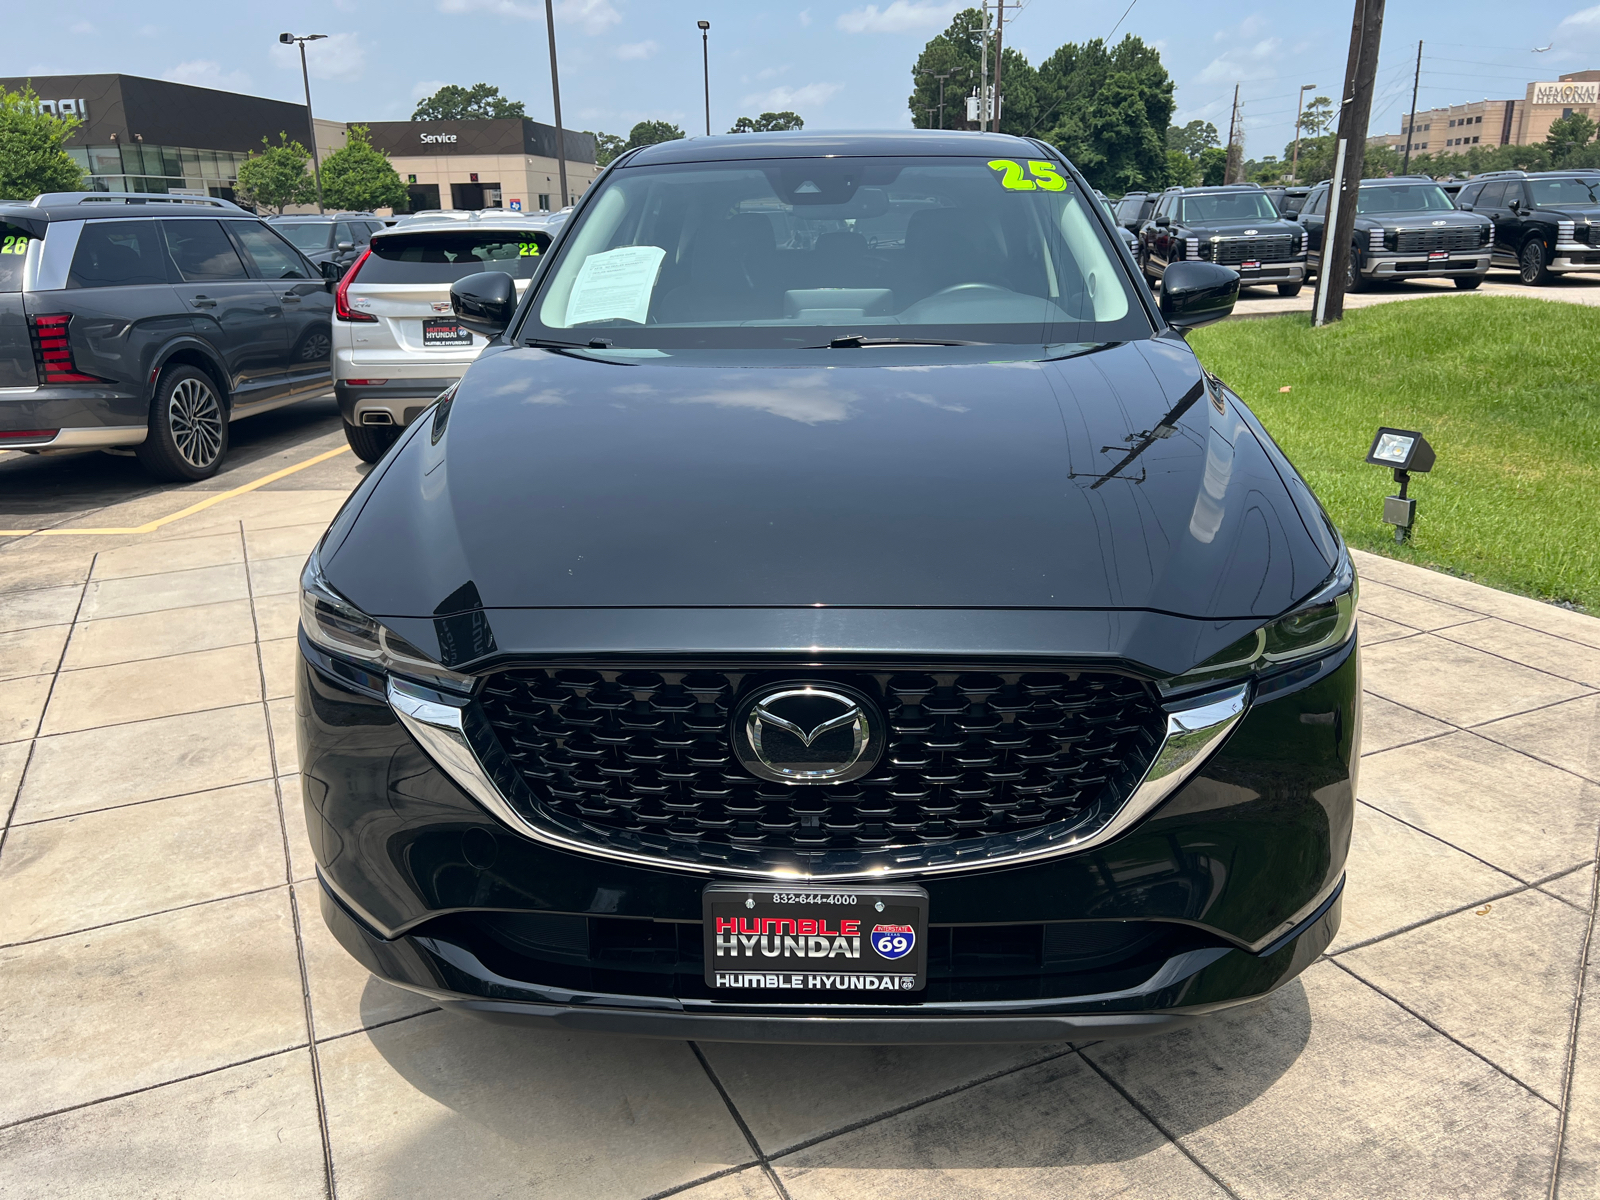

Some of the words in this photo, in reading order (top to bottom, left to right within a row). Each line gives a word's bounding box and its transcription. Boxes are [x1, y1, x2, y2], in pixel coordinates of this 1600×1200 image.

[1538, 85, 1597, 96] MEMORIAL
[1536, 94, 1595, 103] HERMANN
[420, 132, 457, 144] Service
[987, 159, 1067, 192] 25
[1, 235, 28, 255] 26
[518, 242, 540, 256] 22
[426, 331, 458, 339] HYUNDAI
[773, 893, 858, 905] 832-644-4000
[715, 916, 861, 936] HUMBLE
[716, 934, 861, 959] HYUNDAI
[878, 936, 908, 953] 69
[716, 973, 804, 988] HUMBLE
[808, 974, 900, 990] HYUNDAI
